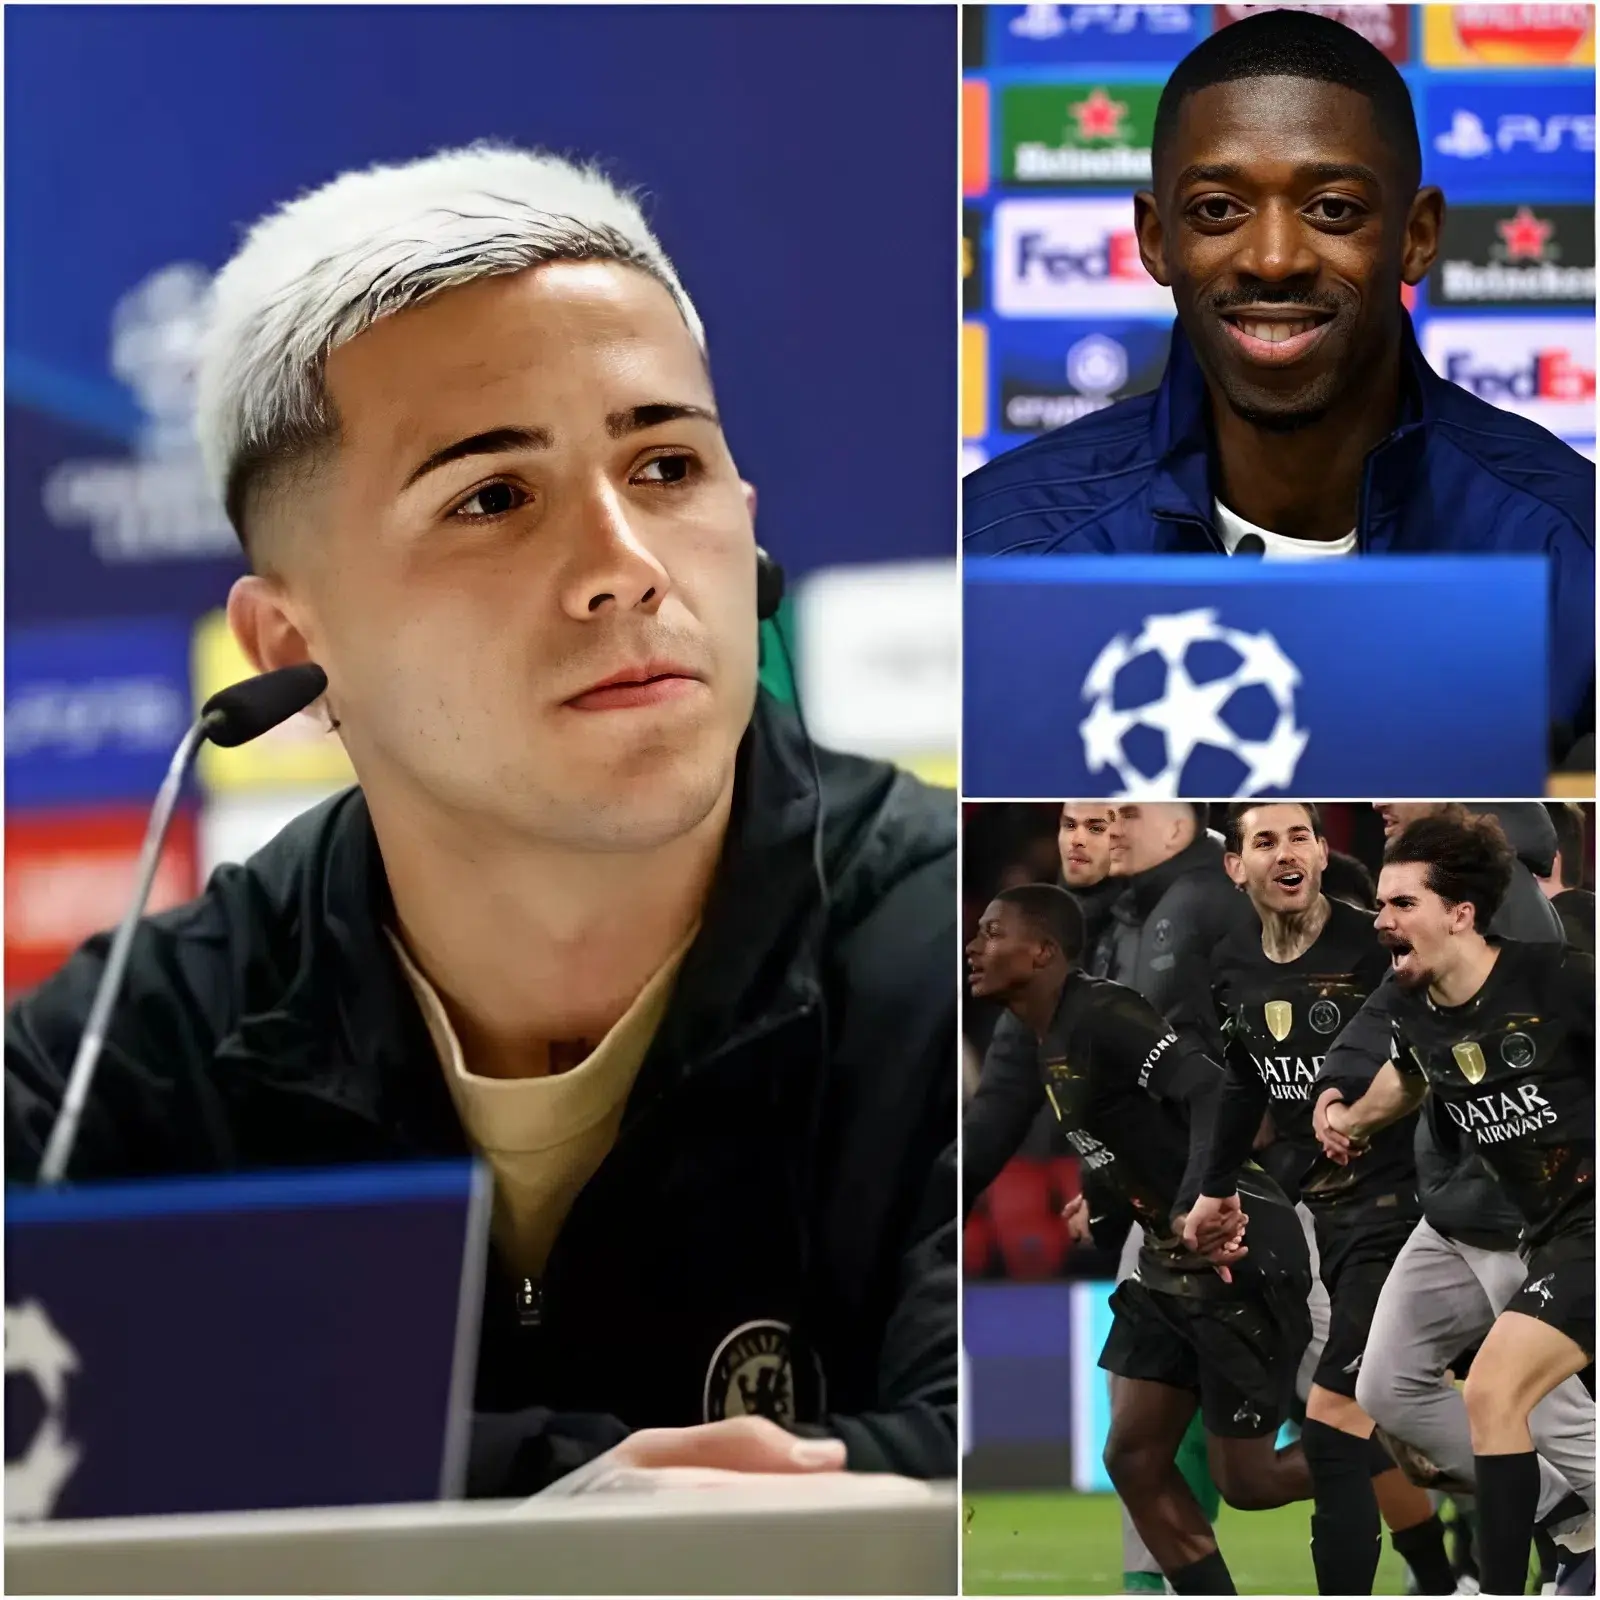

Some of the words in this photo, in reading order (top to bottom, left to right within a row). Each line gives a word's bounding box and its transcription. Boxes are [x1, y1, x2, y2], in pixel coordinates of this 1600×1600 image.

[1015, 229, 1144, 282] FedE
[1444, 1083, 1550, 1133] QATAR
[1475, 1105, 1558, 1145] AIRWAYS
